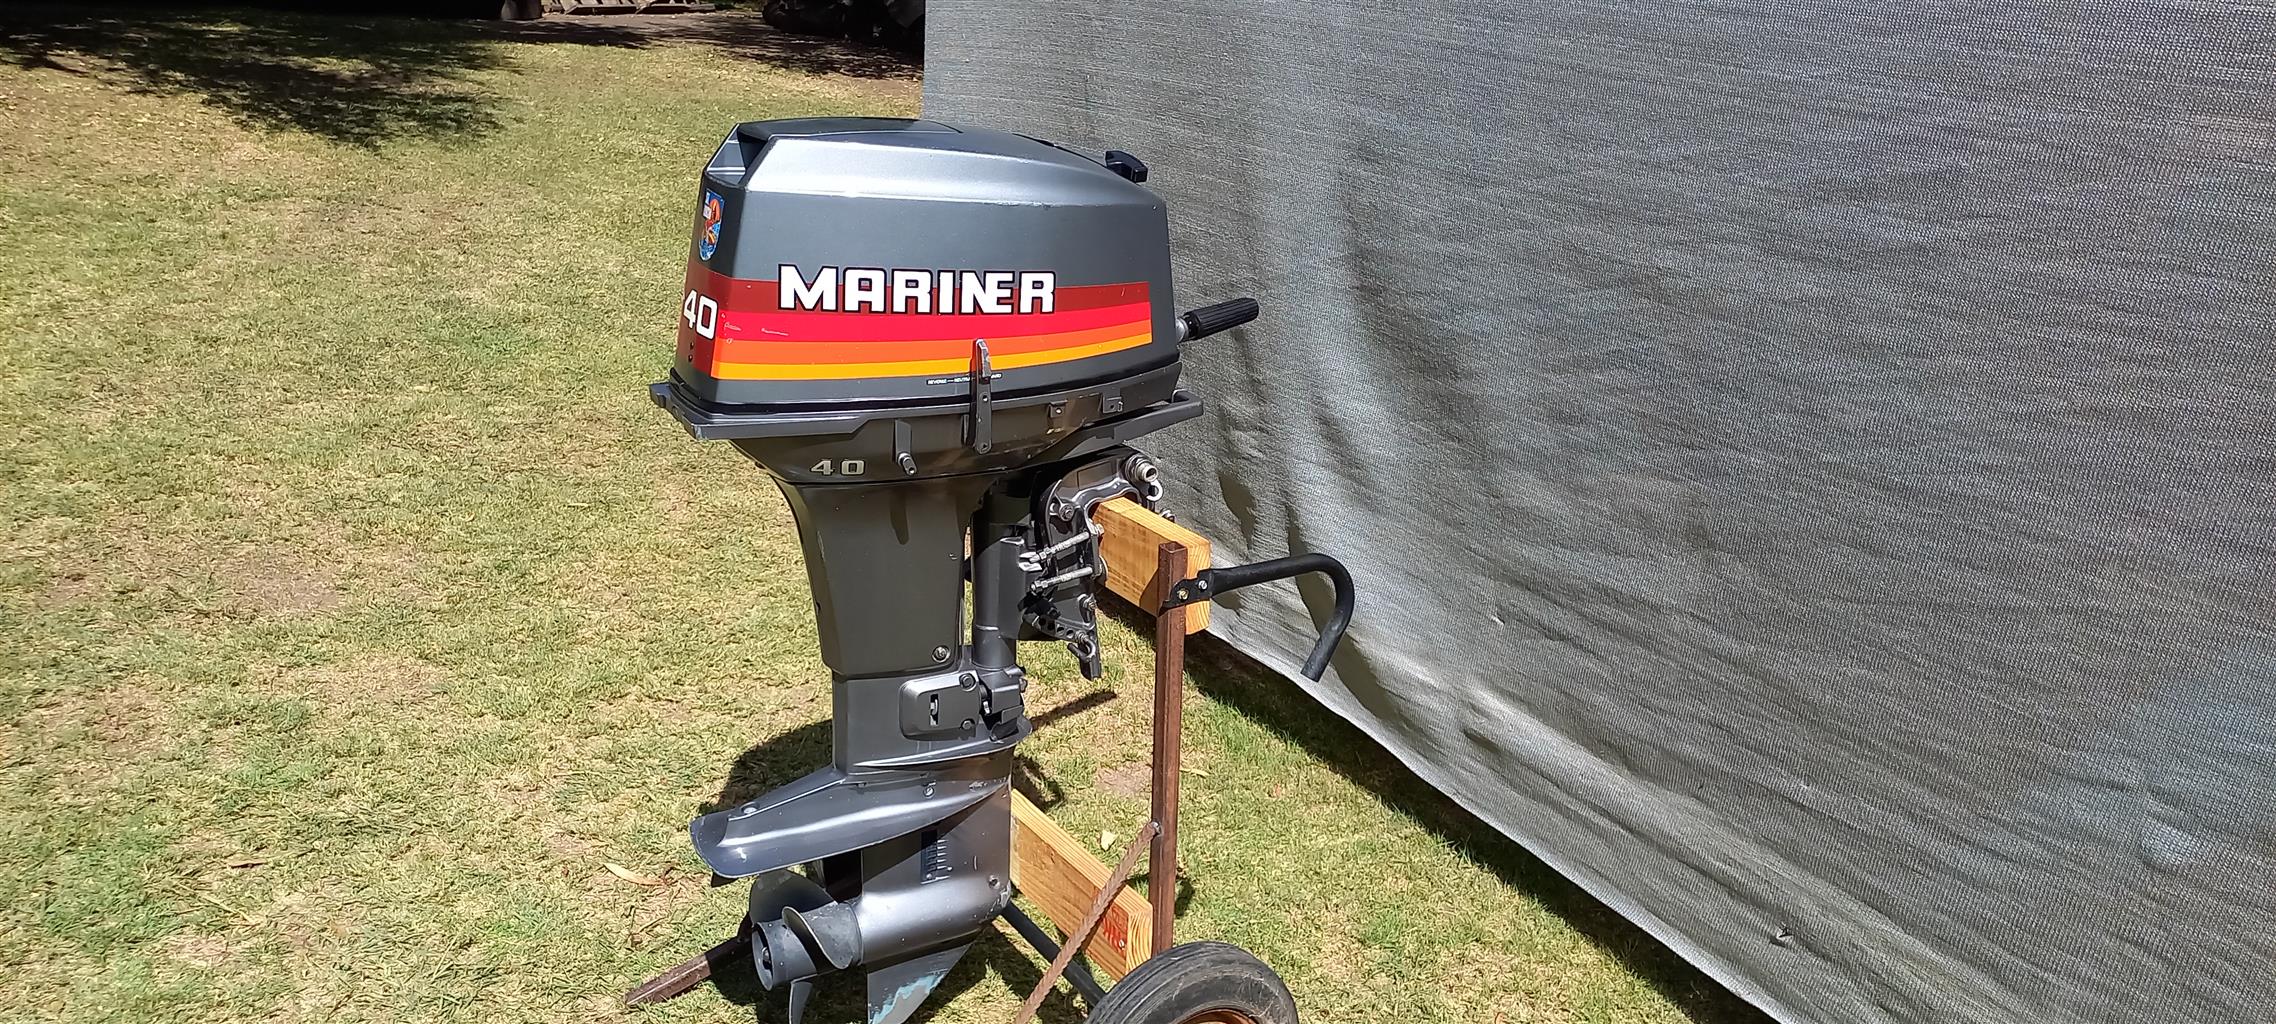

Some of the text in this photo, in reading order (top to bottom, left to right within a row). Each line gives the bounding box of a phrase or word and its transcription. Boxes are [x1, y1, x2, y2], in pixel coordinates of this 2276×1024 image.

[683, 289, 718, 340] 40
[778, 264, 1056, 315] MARINER
[810, 459, 865, 475] 40
